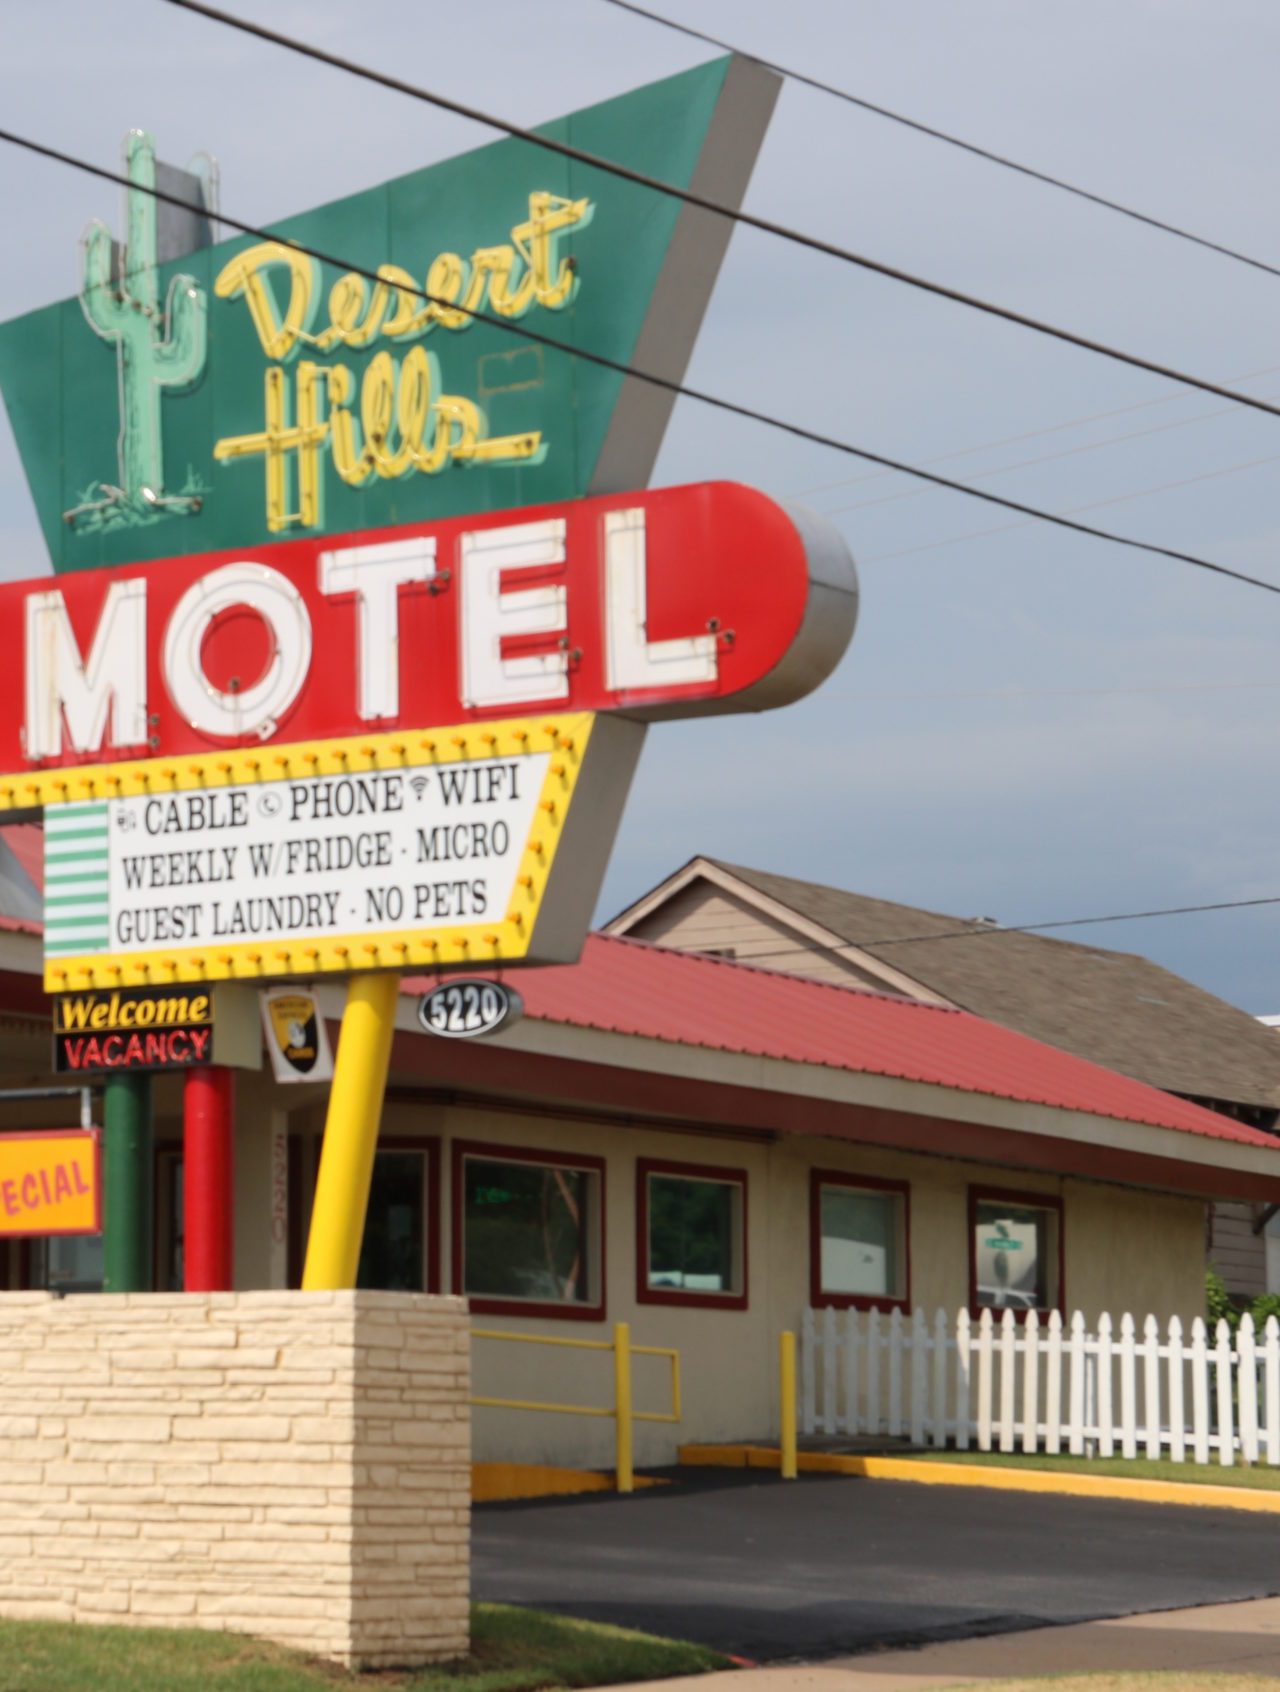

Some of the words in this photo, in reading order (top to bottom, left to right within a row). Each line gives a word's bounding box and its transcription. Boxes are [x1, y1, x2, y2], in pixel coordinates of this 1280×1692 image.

[214, 191, 594, 361] Desert
[214, 345, 547, 533] Hills
[24, 507, 718, 760] MOTEL
[144, 791, 249, 836] CABLE
[289, 776, 404, 822] PHONE
[437, 764, 521, 806] WIFI
[122, 846, 238, 891] WEEKLY
[248, 831, 392, 878] W/FRIDGE
[416, 820, 510, 864] MICRO
[117, 904, 202, 944] GUEST
[212, 891, 341, 936] LAUNDRY
[366, 885, 404, 924] NO
[413, 879, 488, 920] PETS
[62, 991, 209, 1030] Welcome
[431, 985, 498, 1031] 5220
[65, 1029, 210, 1069] VACANCY
